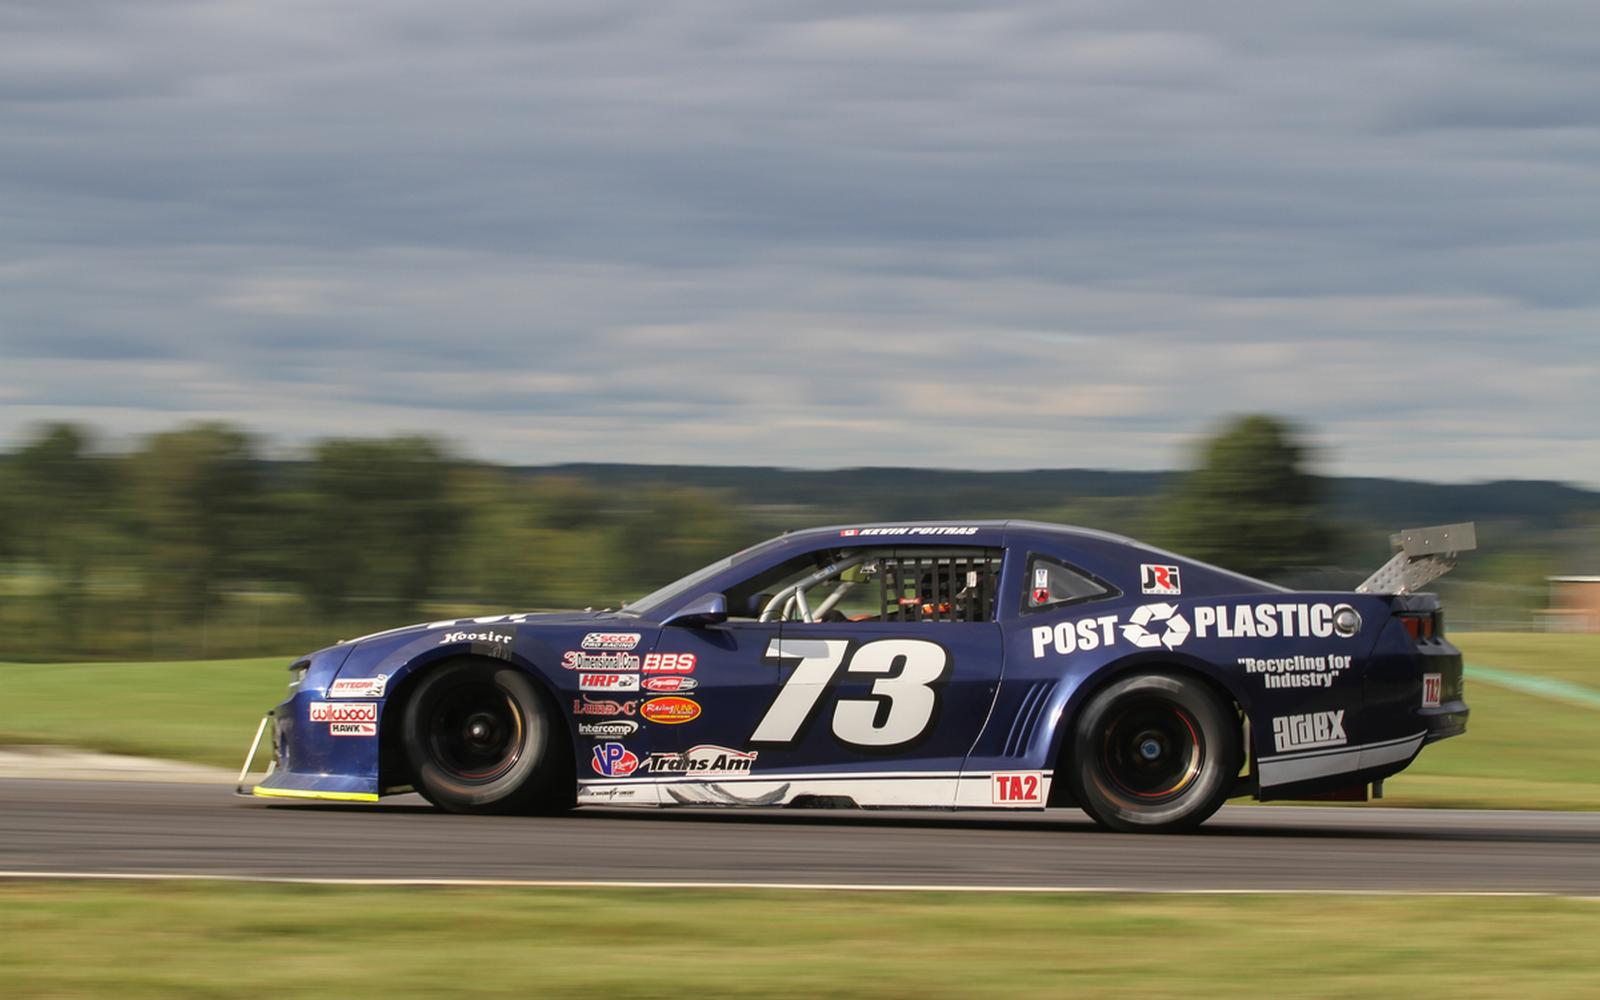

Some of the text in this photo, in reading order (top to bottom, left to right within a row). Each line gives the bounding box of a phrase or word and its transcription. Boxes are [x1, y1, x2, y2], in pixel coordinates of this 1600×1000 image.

[860, 526, 979, 536] KEVIN POITRAS
[600, 635, 636, 643] SCCA
[1032, 615, 1118, 658] POST
[643, 653, 695, 671] BBS
[1237, 654, 1352, 673] "Recycling for
[335, 681, 374, 689] INTEGRA
[581, 674, 620, 687] HRP
[1264, 671, 1340, 689] Industry"
[750, 639, 947, 746] 73
[1424, 677, 1440, 703] TA2
[312, 704, 377, 721] wilwood
[332, 724, 360, 733] HAWK
[578, 723, 633, 736] Intercomp
[592, 742, 626, 776] VP
[649, 754, 708, 771] Trans
[709, 754, 750, 771] Am
[996, 776, 1037, 800] TA2
